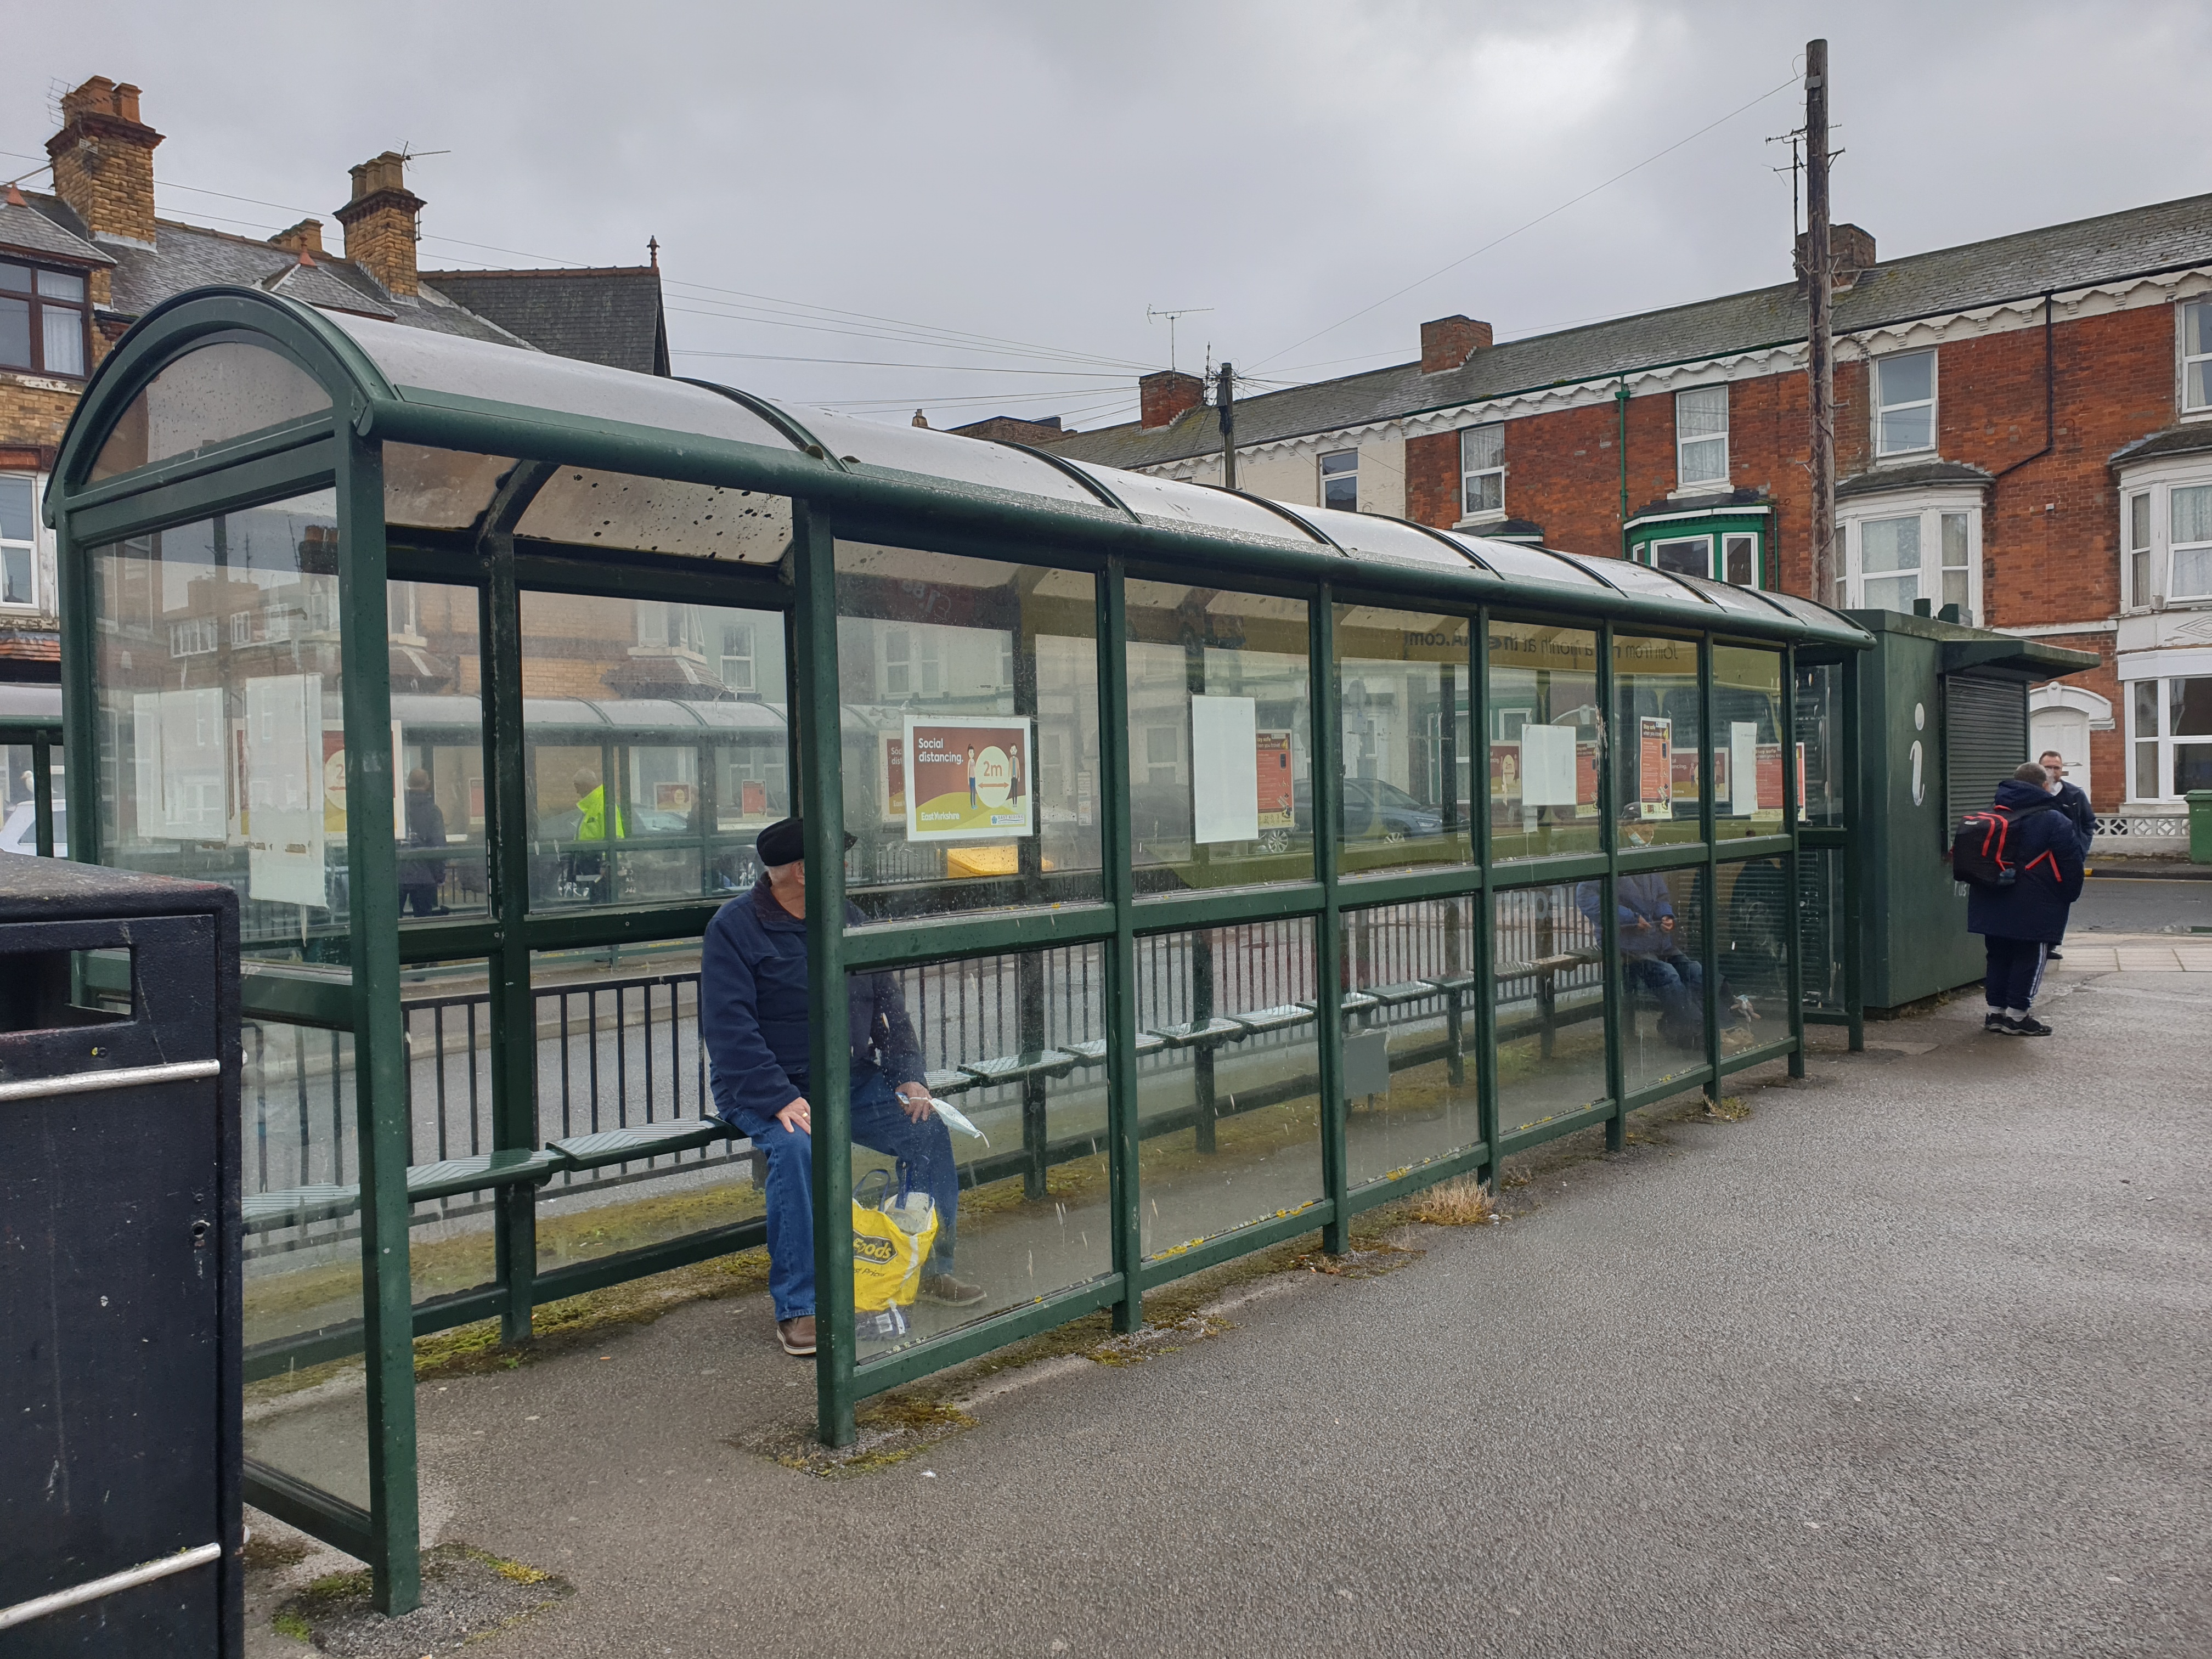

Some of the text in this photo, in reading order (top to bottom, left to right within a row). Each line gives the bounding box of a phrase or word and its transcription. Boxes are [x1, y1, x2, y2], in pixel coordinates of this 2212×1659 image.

[918, 737, 944, 749] Social
[918, 751, 964, 765] distancing.
[336, 764, 345, 779] 2
[983, 760, 1002, 777] 2m
[921, 811, 960, 821] East Yorkshire
